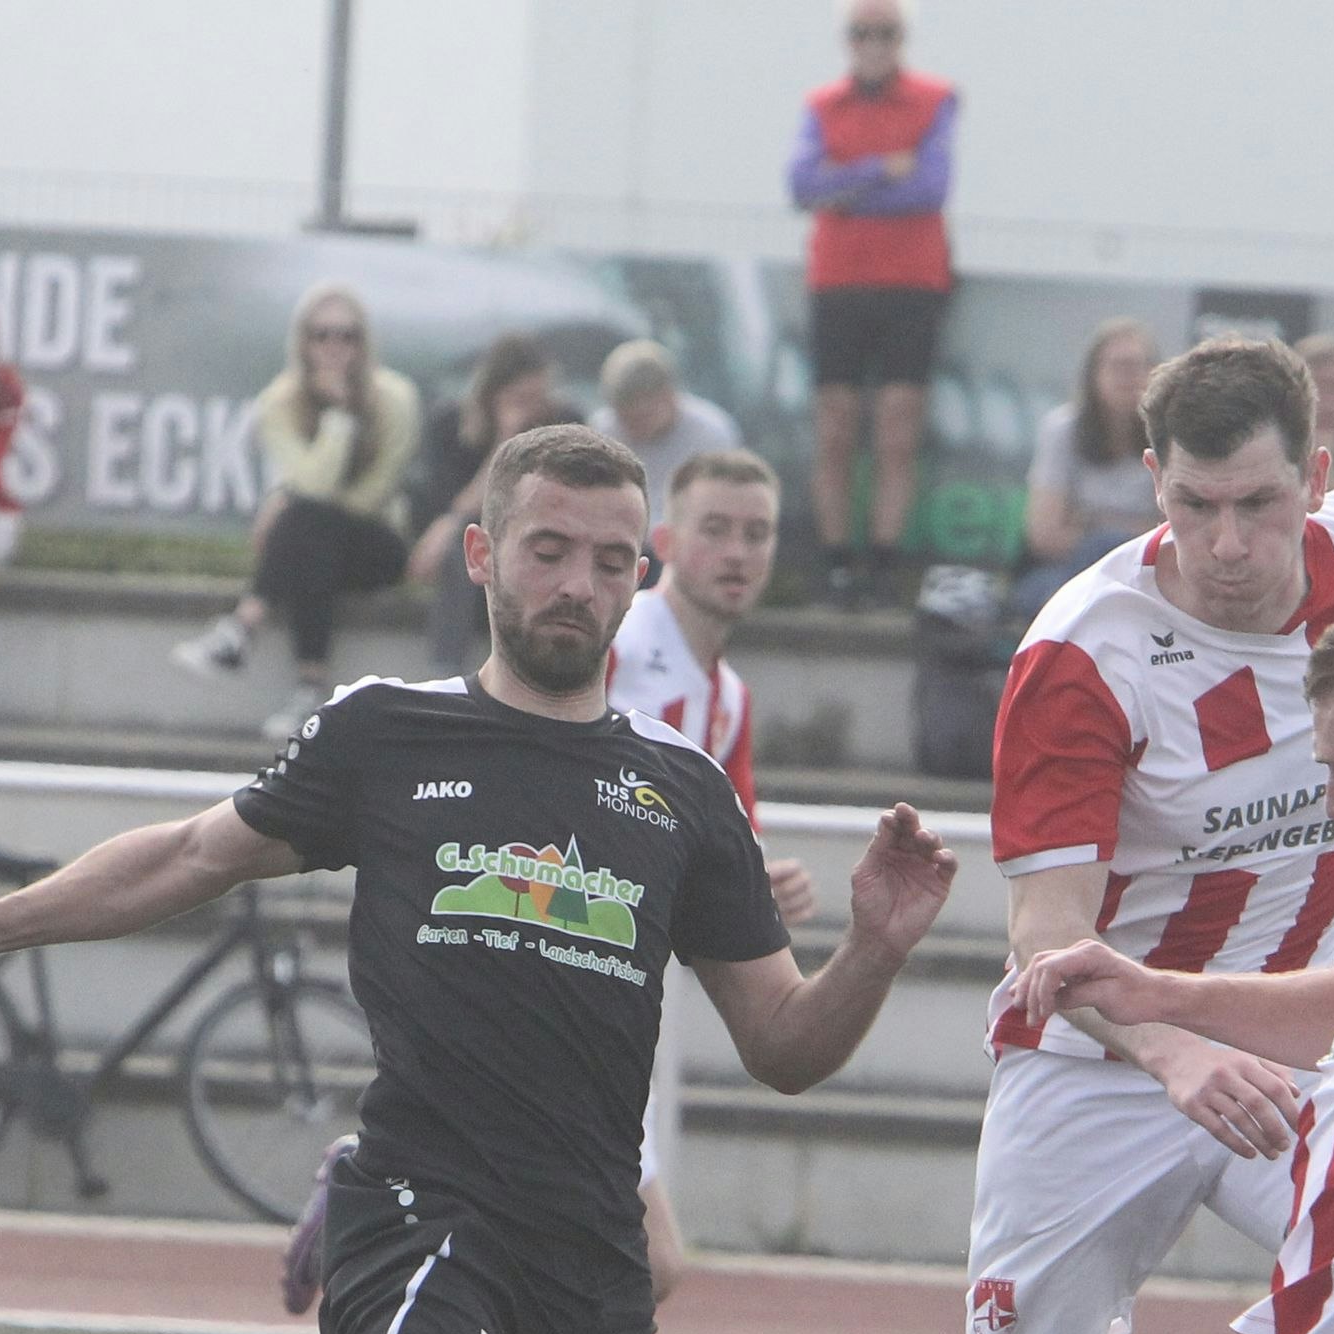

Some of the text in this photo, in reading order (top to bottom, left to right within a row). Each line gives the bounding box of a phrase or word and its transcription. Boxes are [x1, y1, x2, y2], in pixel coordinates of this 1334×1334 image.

[86, 394, 274, 514] ECK
[1150, 649, 1195, 666] erima
[413, 781, 473, 800] JAKO
[594, 778, 630, 801] TUS
[1203, 783, 1326, 834] SAUNAP
[597, 793, 679, 832] MONDORF
[435, 842, 645, 907] G.Schumacher
[416, 925, 468, 944] Garten
[539, 938, 647, 987] Landschaftsbau
